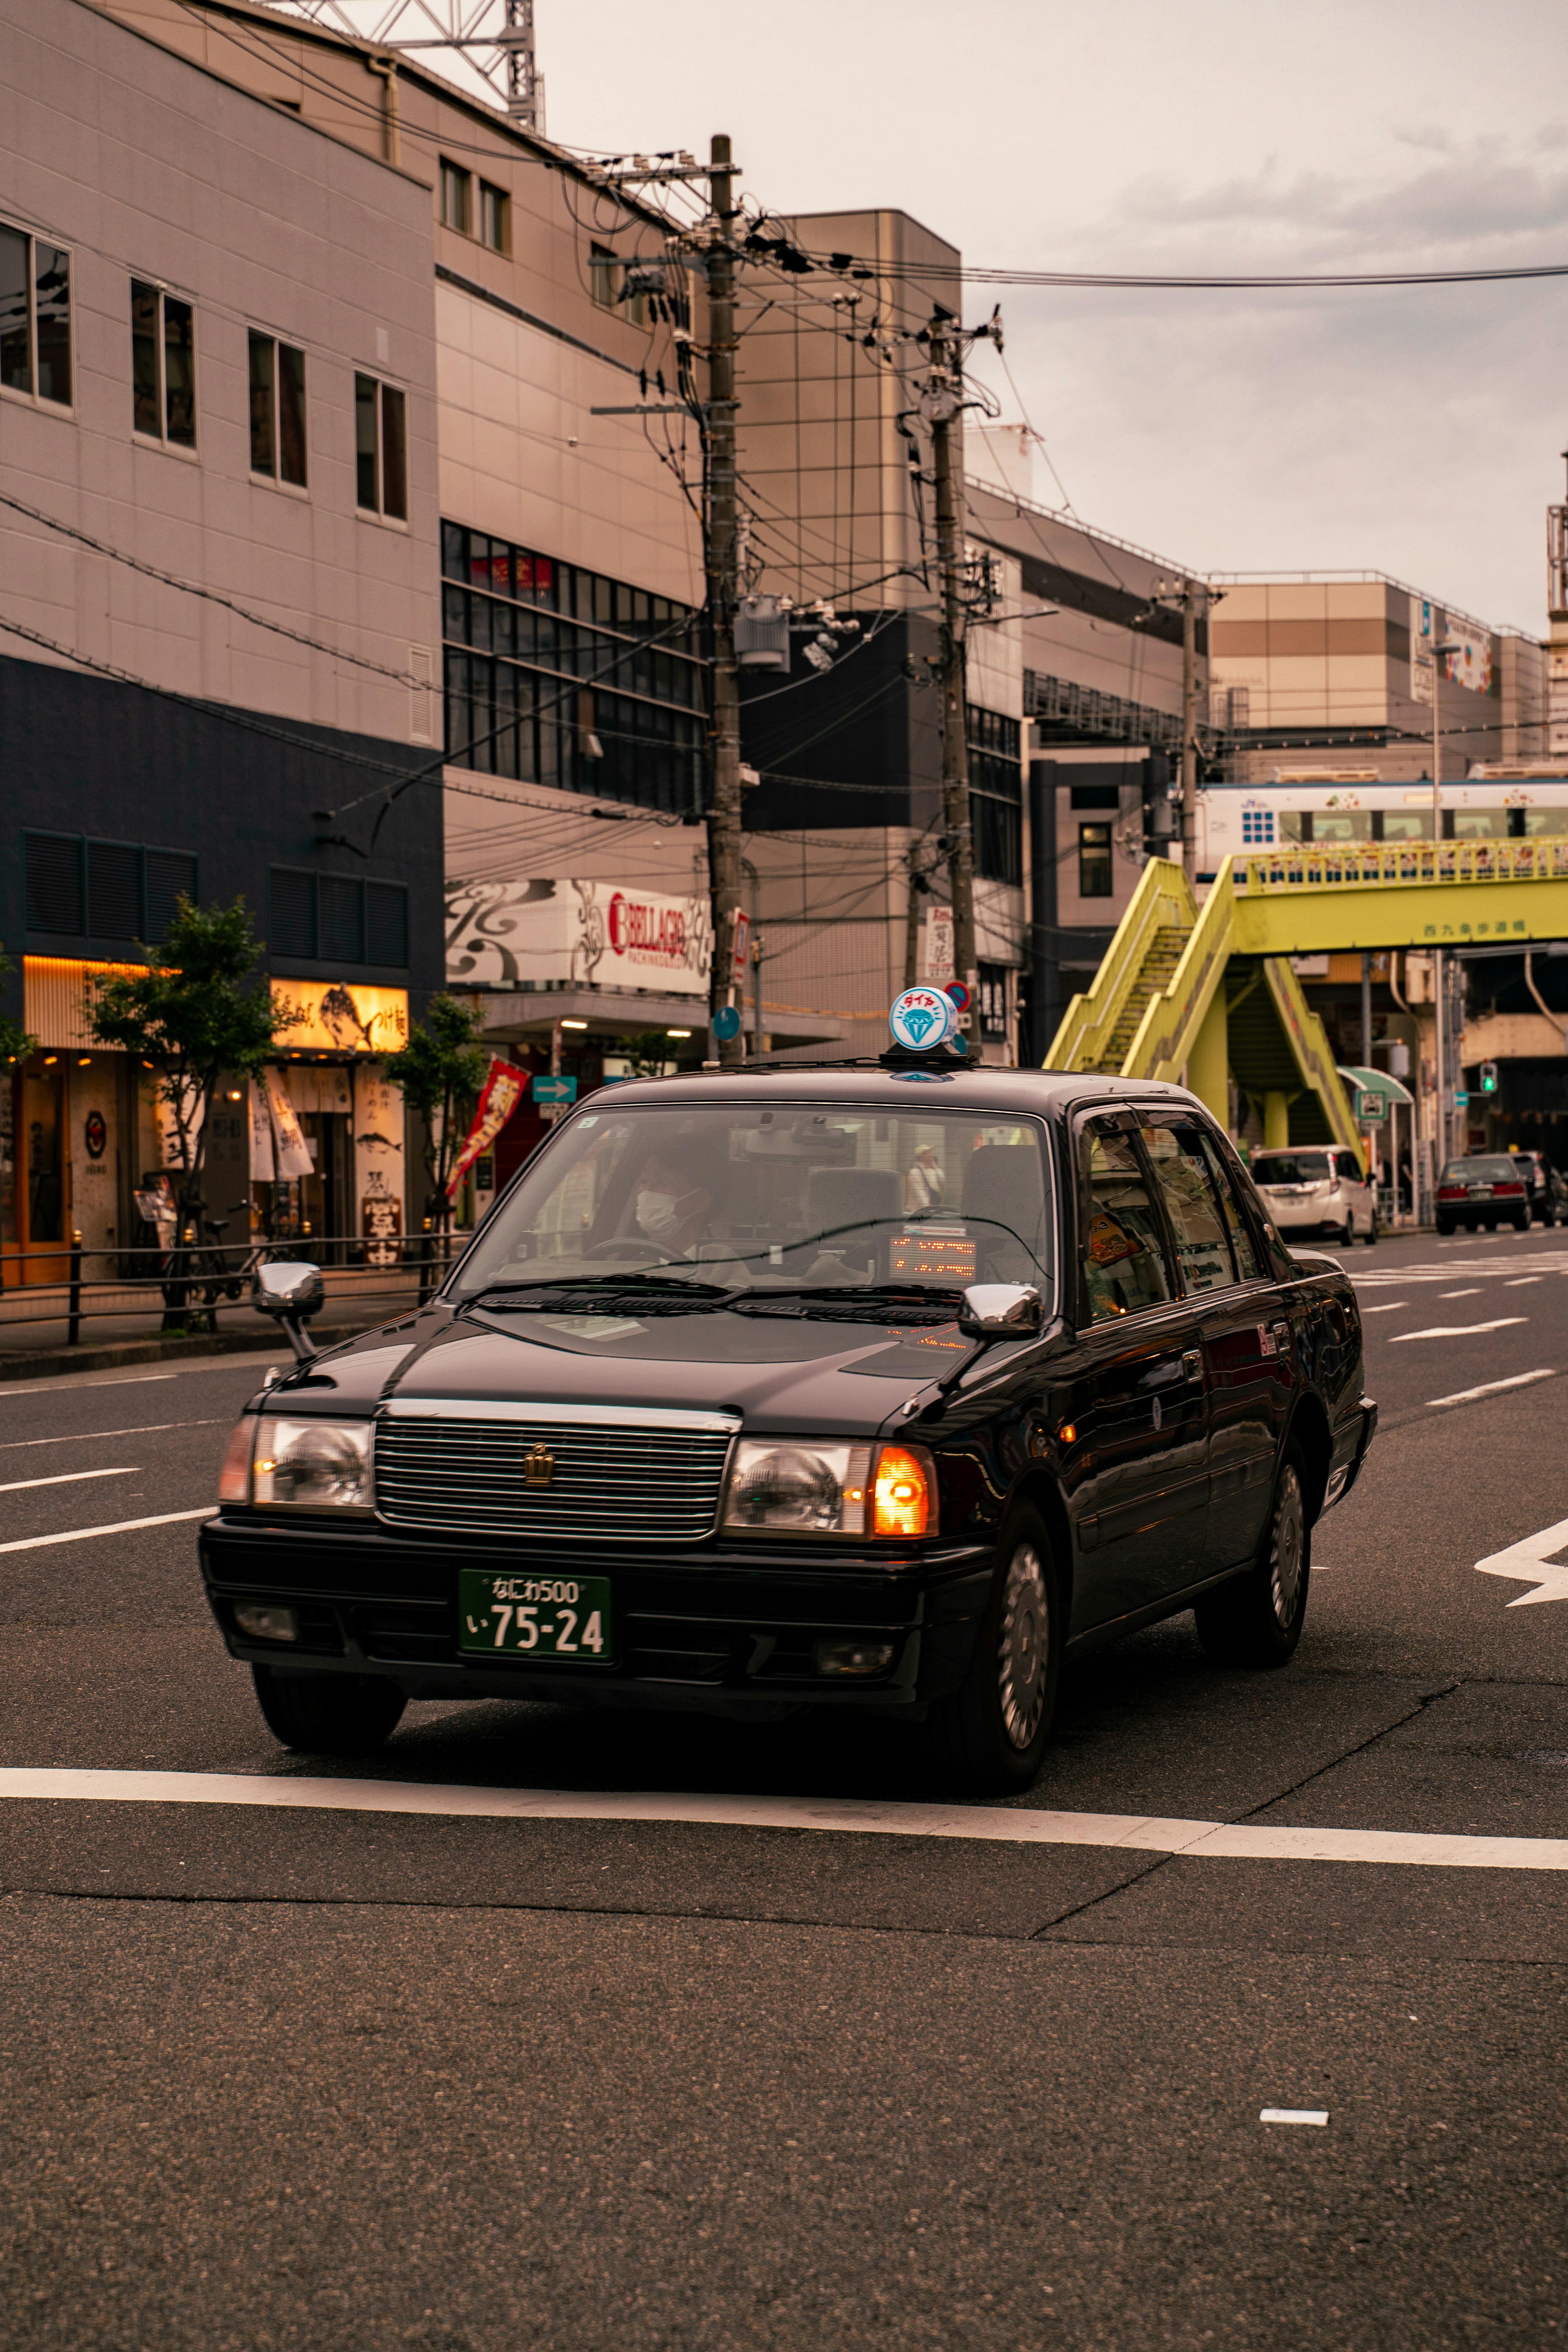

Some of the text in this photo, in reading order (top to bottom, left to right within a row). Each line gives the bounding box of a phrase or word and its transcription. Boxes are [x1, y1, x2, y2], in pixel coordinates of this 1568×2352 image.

[904, 994, 935, 1007] ダイヤ
[492, 1577, 579, 1604] なにわ 500
[466, 1604, 604, 1653] い 75-24
